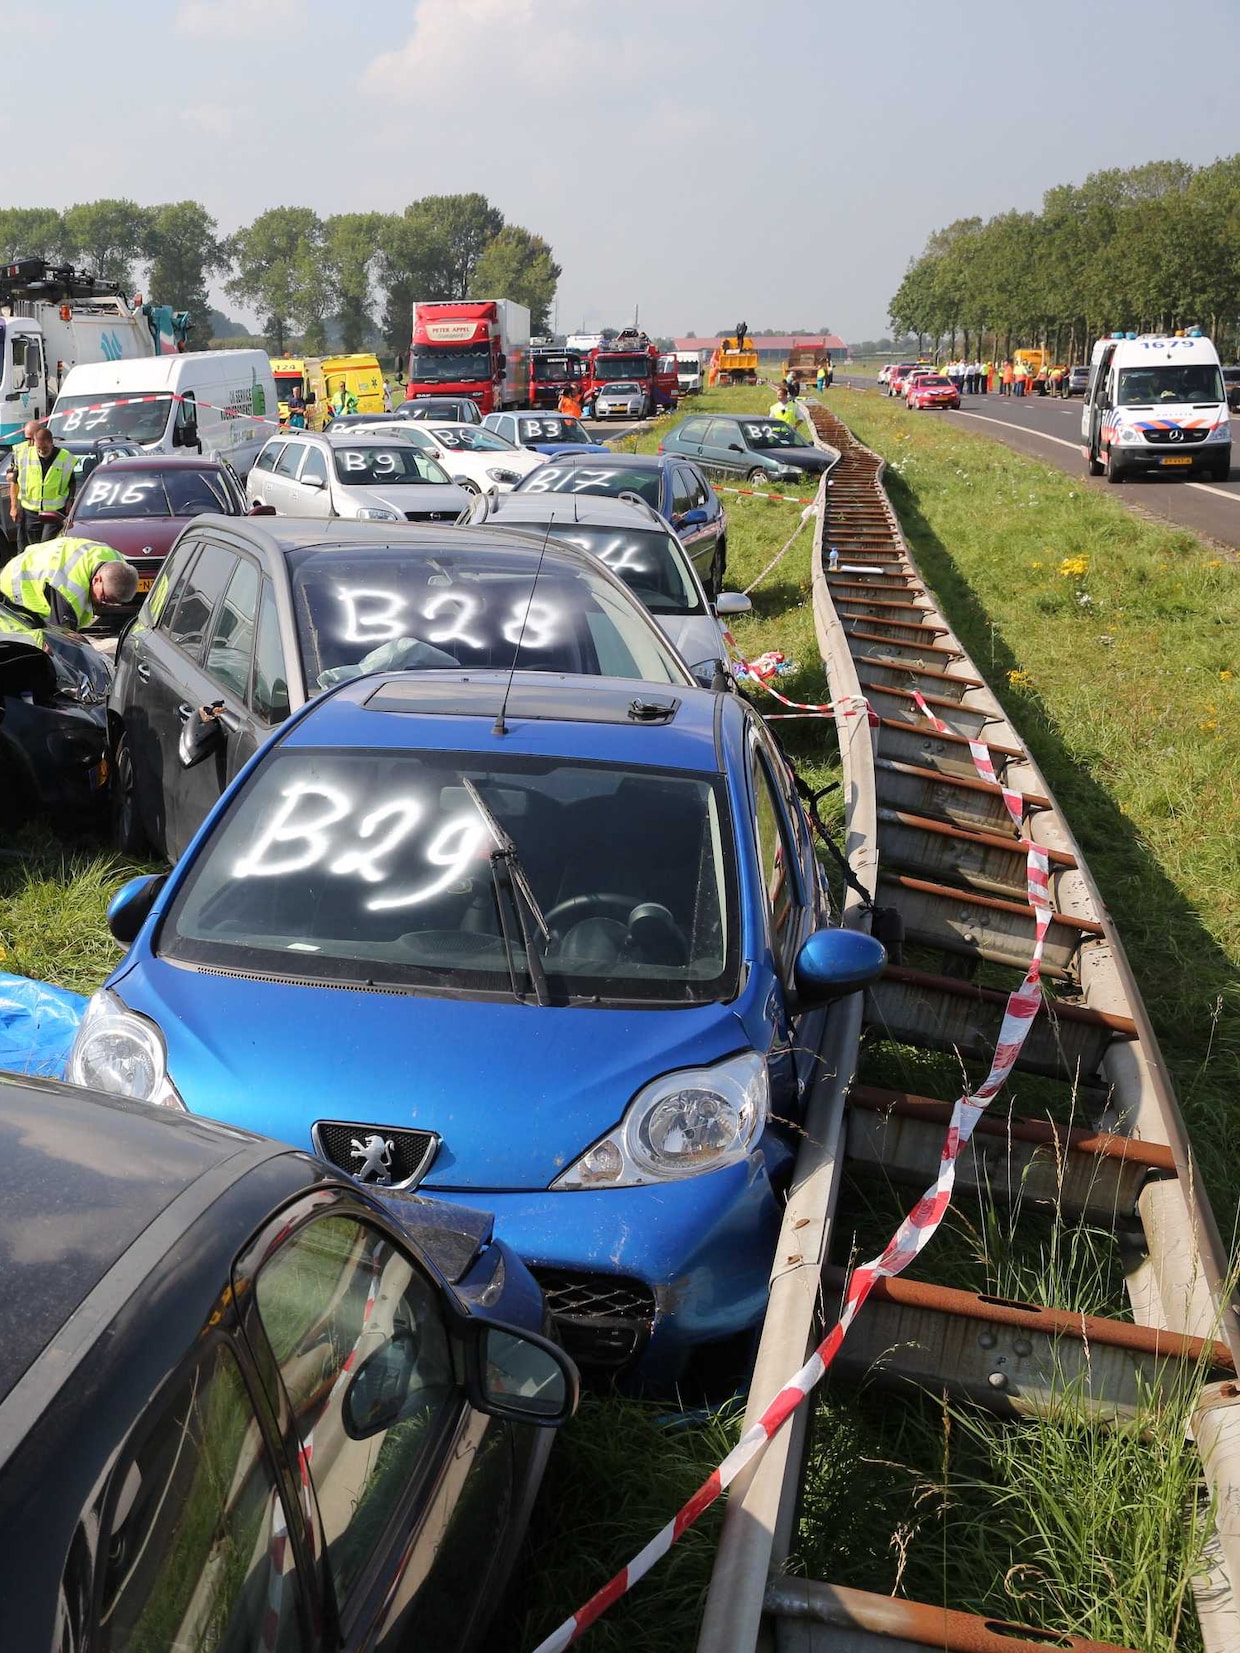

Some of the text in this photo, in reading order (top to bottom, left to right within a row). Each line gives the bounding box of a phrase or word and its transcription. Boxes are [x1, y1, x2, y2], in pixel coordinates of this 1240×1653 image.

[1140, 341, 1194, 349] 1679
[62, 408, 111, 432] B7
[526, 420, 561, 438] B3
[433, 429, 476, 446] B6
[747, 425, 779, 439] B2
[345, 452, 396, 475] B9
[524, 469, 617, 493] B17
[336, 584, 562, 650] B28
[231, 778, 491, 912] B29
